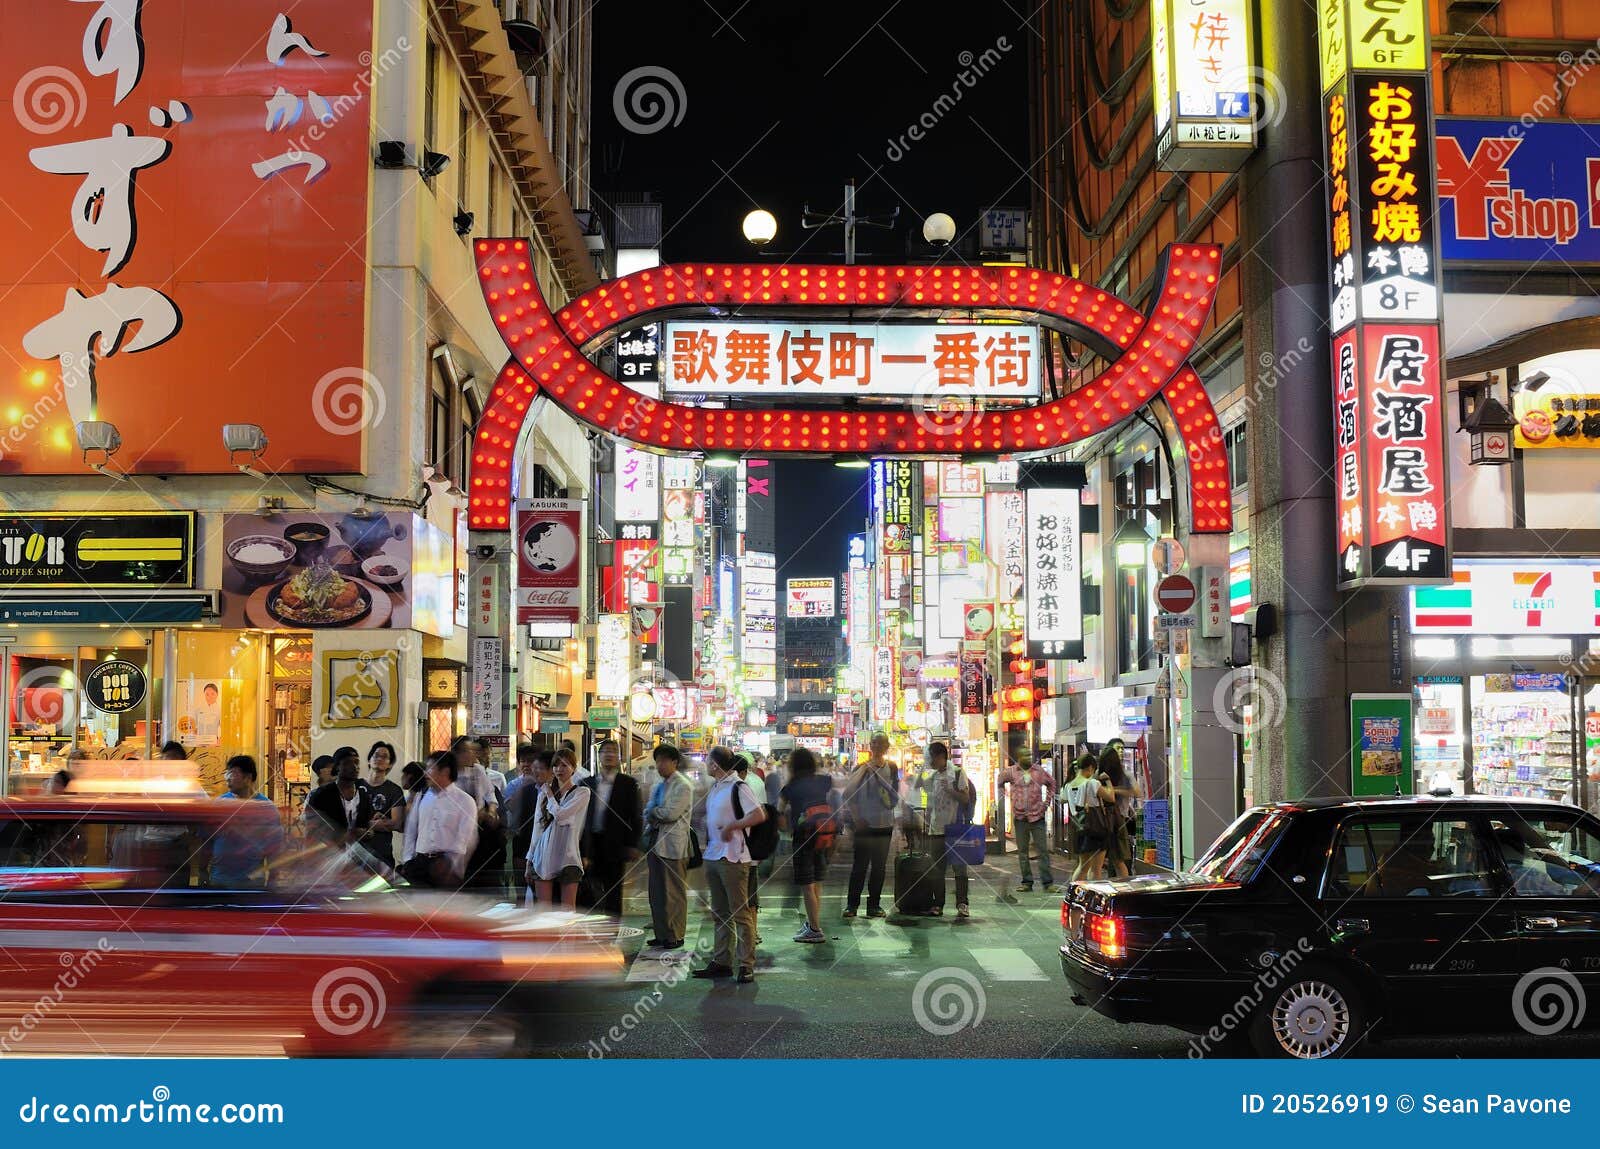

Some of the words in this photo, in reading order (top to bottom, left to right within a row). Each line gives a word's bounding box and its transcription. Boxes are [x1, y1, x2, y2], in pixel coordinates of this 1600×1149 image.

[1373, 50, 1403, 63] 6F
[1219, 93, 1243, 115] 7F
[1189, 126, 1240, 141] 小松ビル
[1379, 284, 1421, 311] 8F
[672, 328, 1032, 387] 歌舞伎町一番街
[623, 362, 652, 376] 3F
[1339, 342, 1360, 500] 居酒屋
[1372, 335, 1434, 497] 居酒屋
[622, 525, 652, 539] 焼肉
[1385, 542, 1431, 572] 4F
[0, 568, 34, 576] OFFEE
[37, 568, 64, 576] SHOP
[103, 674, 129, 688] DOU
[102, 687, 130, 701] TOR
[1449, 959, 1475, 970] 236
